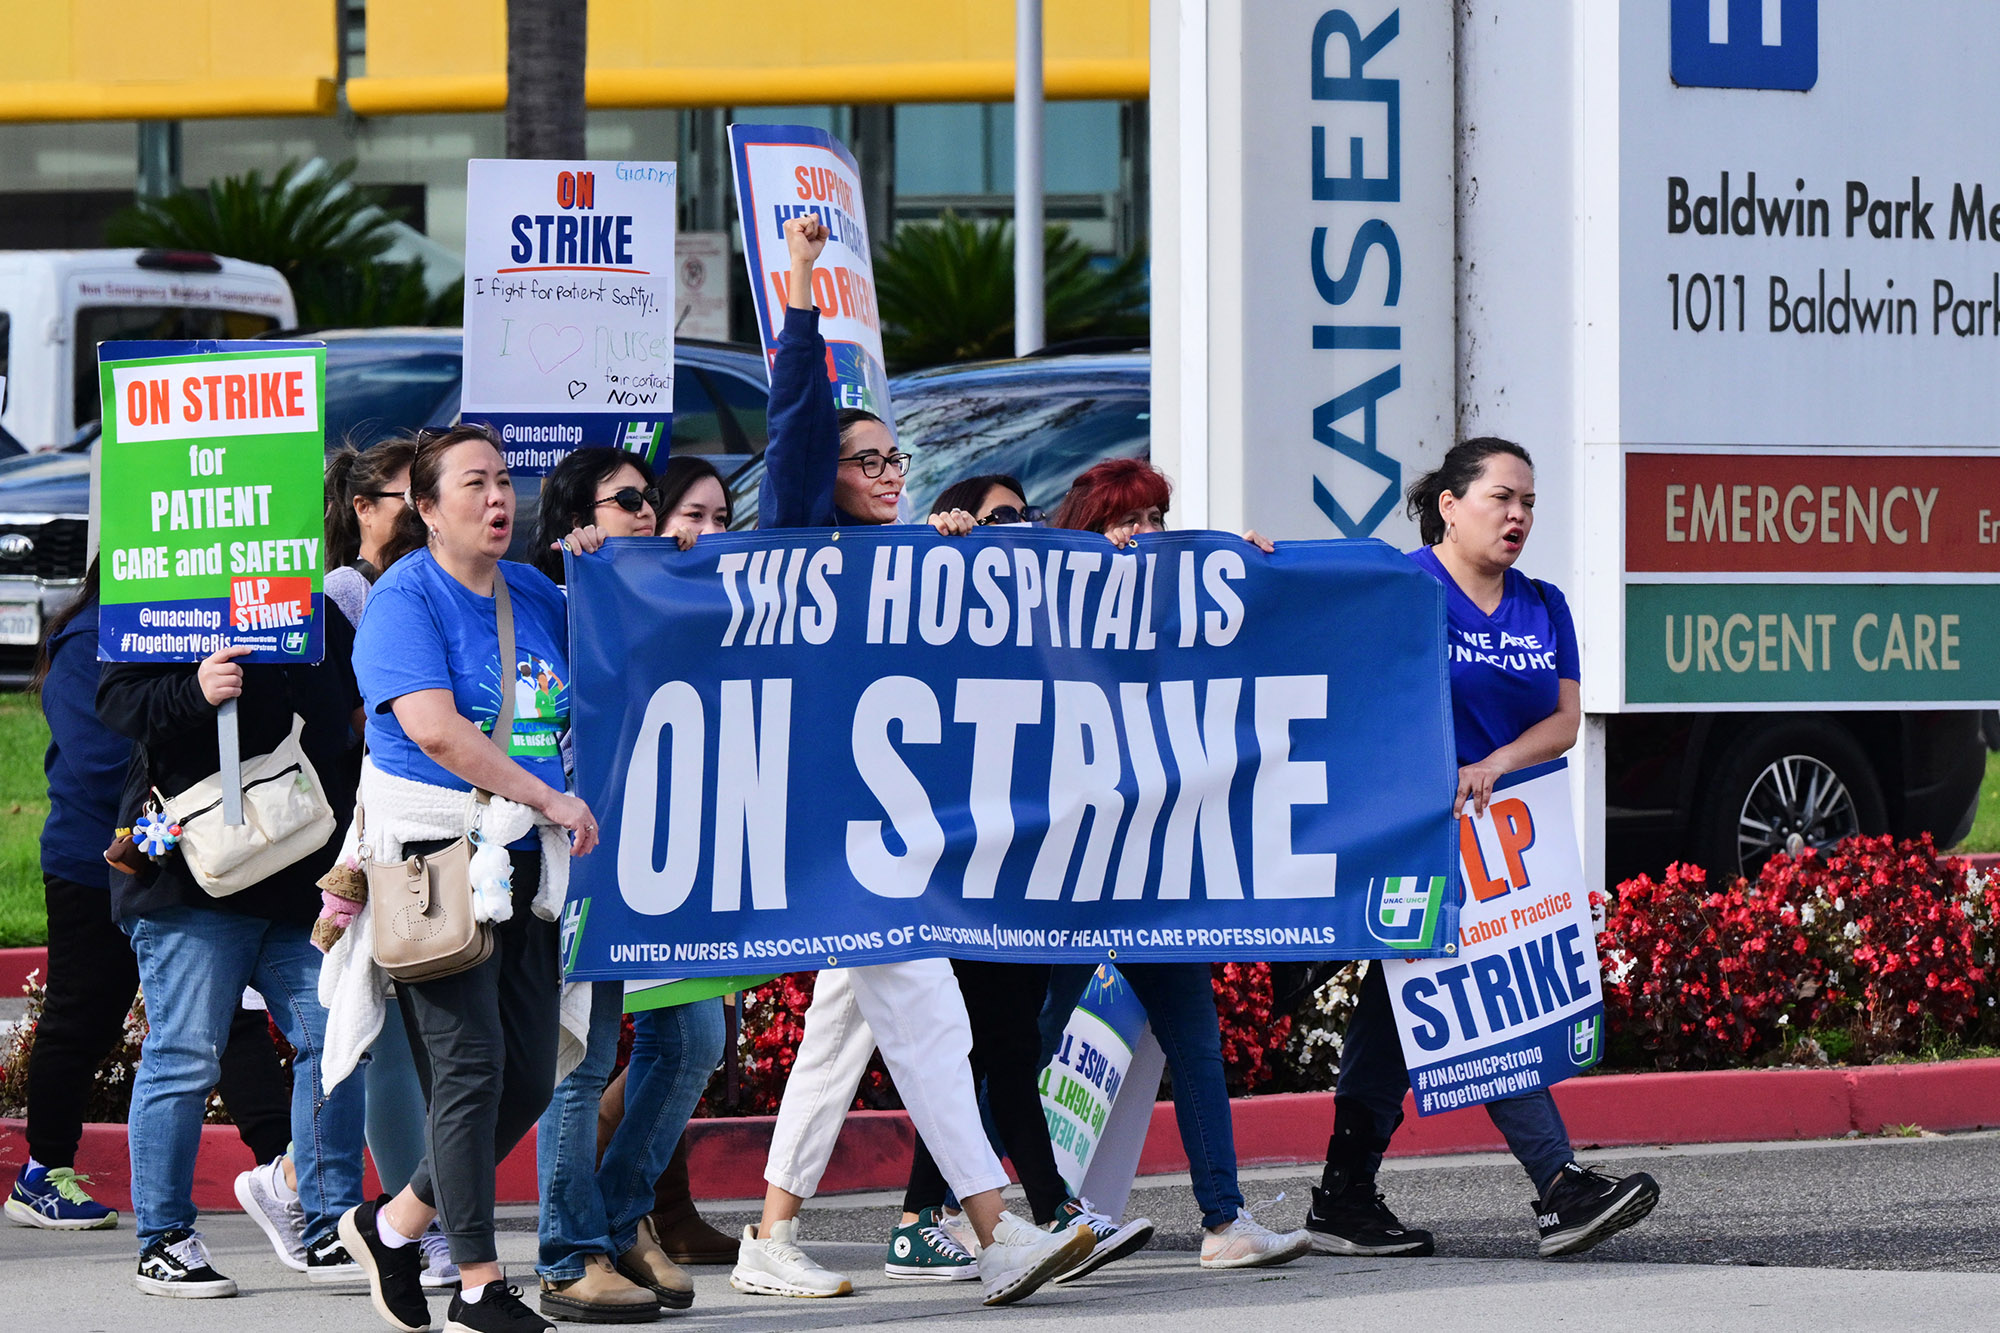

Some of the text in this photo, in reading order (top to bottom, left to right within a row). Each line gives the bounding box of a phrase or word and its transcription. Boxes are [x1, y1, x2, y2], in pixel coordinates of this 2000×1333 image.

[557, 171, 595, 210] ON
[794, 165, 856, 219] SUPPORT
[1667, 171, 1829, 237] Baldwin
[1846, 176, 1935, 240] Park
[511, 214, 633, 265] STRIKE
[774, 204, 868, 268] HLTHCARE
[474, 278, 484, 295] I
[491, 278, 527, 303] fight
[531, 279, 553, 300] for
[1311, 8, 1402, 538] KAISER
[1667, 272, 1745, 333] 1011
[1769, 268, 1917, 335] Baldwin
[499, 318, 515, 357] I
[127, 371, 306, 427] ON STRIKE
[604, 366, 674, 390] fair contract
[607, 389, 658, 406] NOW
[502, 424, 583, 445] @unacuhcp
[189, 445, 226, 477] for
[151, 485, 273, 532] PATIENT
[1665, 483, 1940, 544] EMERGENCY
[112, 538, 319, 580] CARE and SAFETY
[233, 579, 270, 607] ULP
[716, 545, 1246, 651] THIS HOSPITAL IS
[139, 608, 221, 630] @unacuhcp
[235, 600, 304, 632] STRIKE
[120, 633, 231, 654] #TogetherWeRis
[1448, 645, 1557, 671] NAC/UHC
[1500, 632, 1543, 650] ARE
[1665, 613, 1960, 673] URGENT CARE
[617, 674, 1338, 916] ON STRIKE
[1459, 797, 1536, 909] LP
[1459, 892, 1573, 947] Labor Practice
[610, 923, 1336, 962] UNITED NURSES ASSOCIATIONS OF CALIFORNIA/UNION OF HEALTH CARE PROFESSIONALS
[1401, 923, 1592, 1052] STRIKE
[1075, 1041, 1109, 1089] RISE
[1418, 1046, 1543, 1090] #UNACUHCPstrong
[1054, 1075, 1095, 1124] FIGHT
[1422, 1069, 1541, 1112] #TogetherWeWin
[1538, 1212, 1560, 1228] OKA
